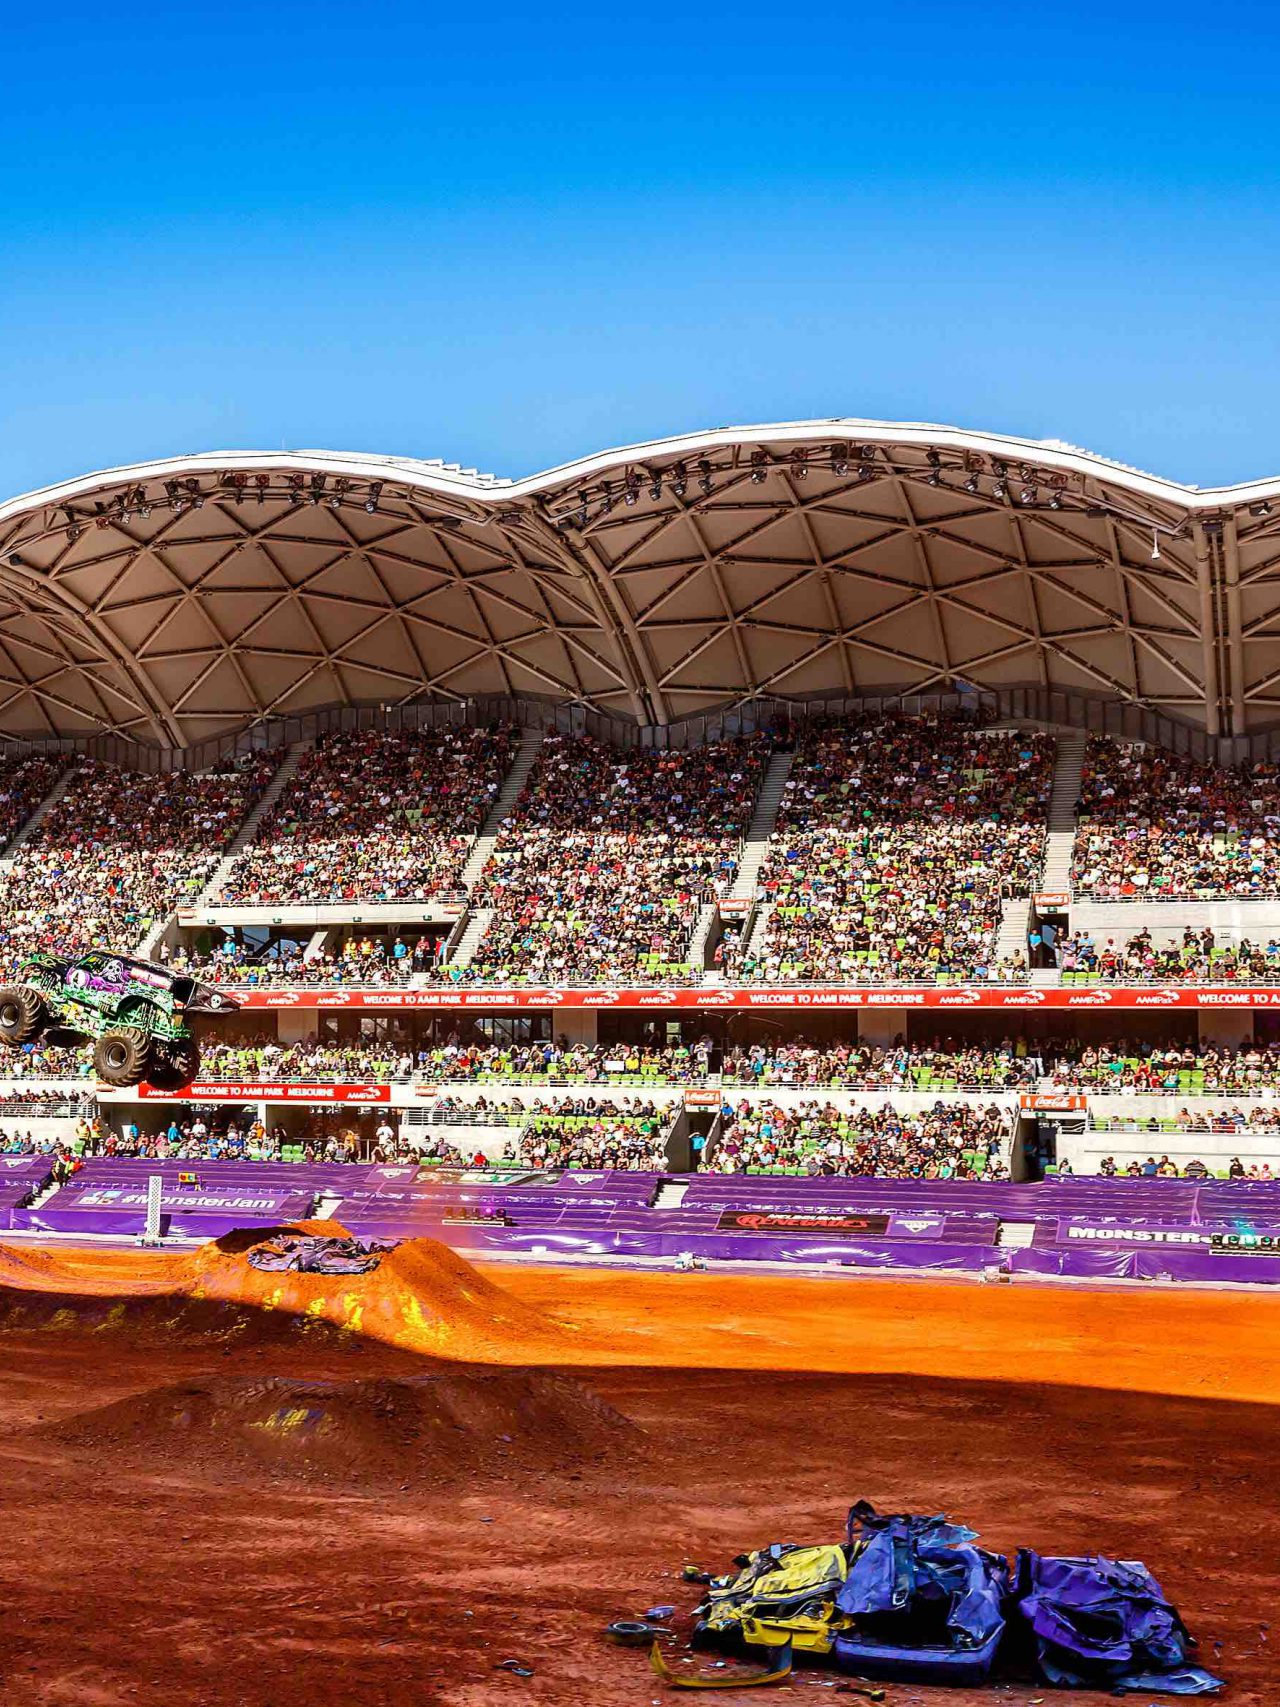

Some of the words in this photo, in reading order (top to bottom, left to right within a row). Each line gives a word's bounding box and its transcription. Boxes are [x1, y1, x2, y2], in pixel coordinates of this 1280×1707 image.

[363, 996, 403, 1004] WELCOME
[405, 996, 416, 1004] TO
[417, 996, 440, 1004] AAMI
[442, 996, 462, 1004] PARK
[465, 996, 516, 1004] MELBOURNE
[750, 994, 795, 1004] WELCOME
[797, 994, 810, 1004] TO
[812, 994, 838, 1004] AAMI
[839, 994, 863, 1004] PARK
[868, 994, 925, 1004] MELBOURNE
[1198, 994, 1250, 1004] WELCOME
[1252, 994, 1268, 1004] TO
[191, 1086, 230, 1095] WELCOME
[230, 1087, 241, 1096] TO
[242, 1087, 264, 1096] AAMI
[264, 1088, 284, 1096] PARK
[288, 1088, 334, 1097] MELBOURNE
[1034, 1096, 1070, 1108] Coca-Cola
[766, 1213, 847, 1221] MELBOURNE
